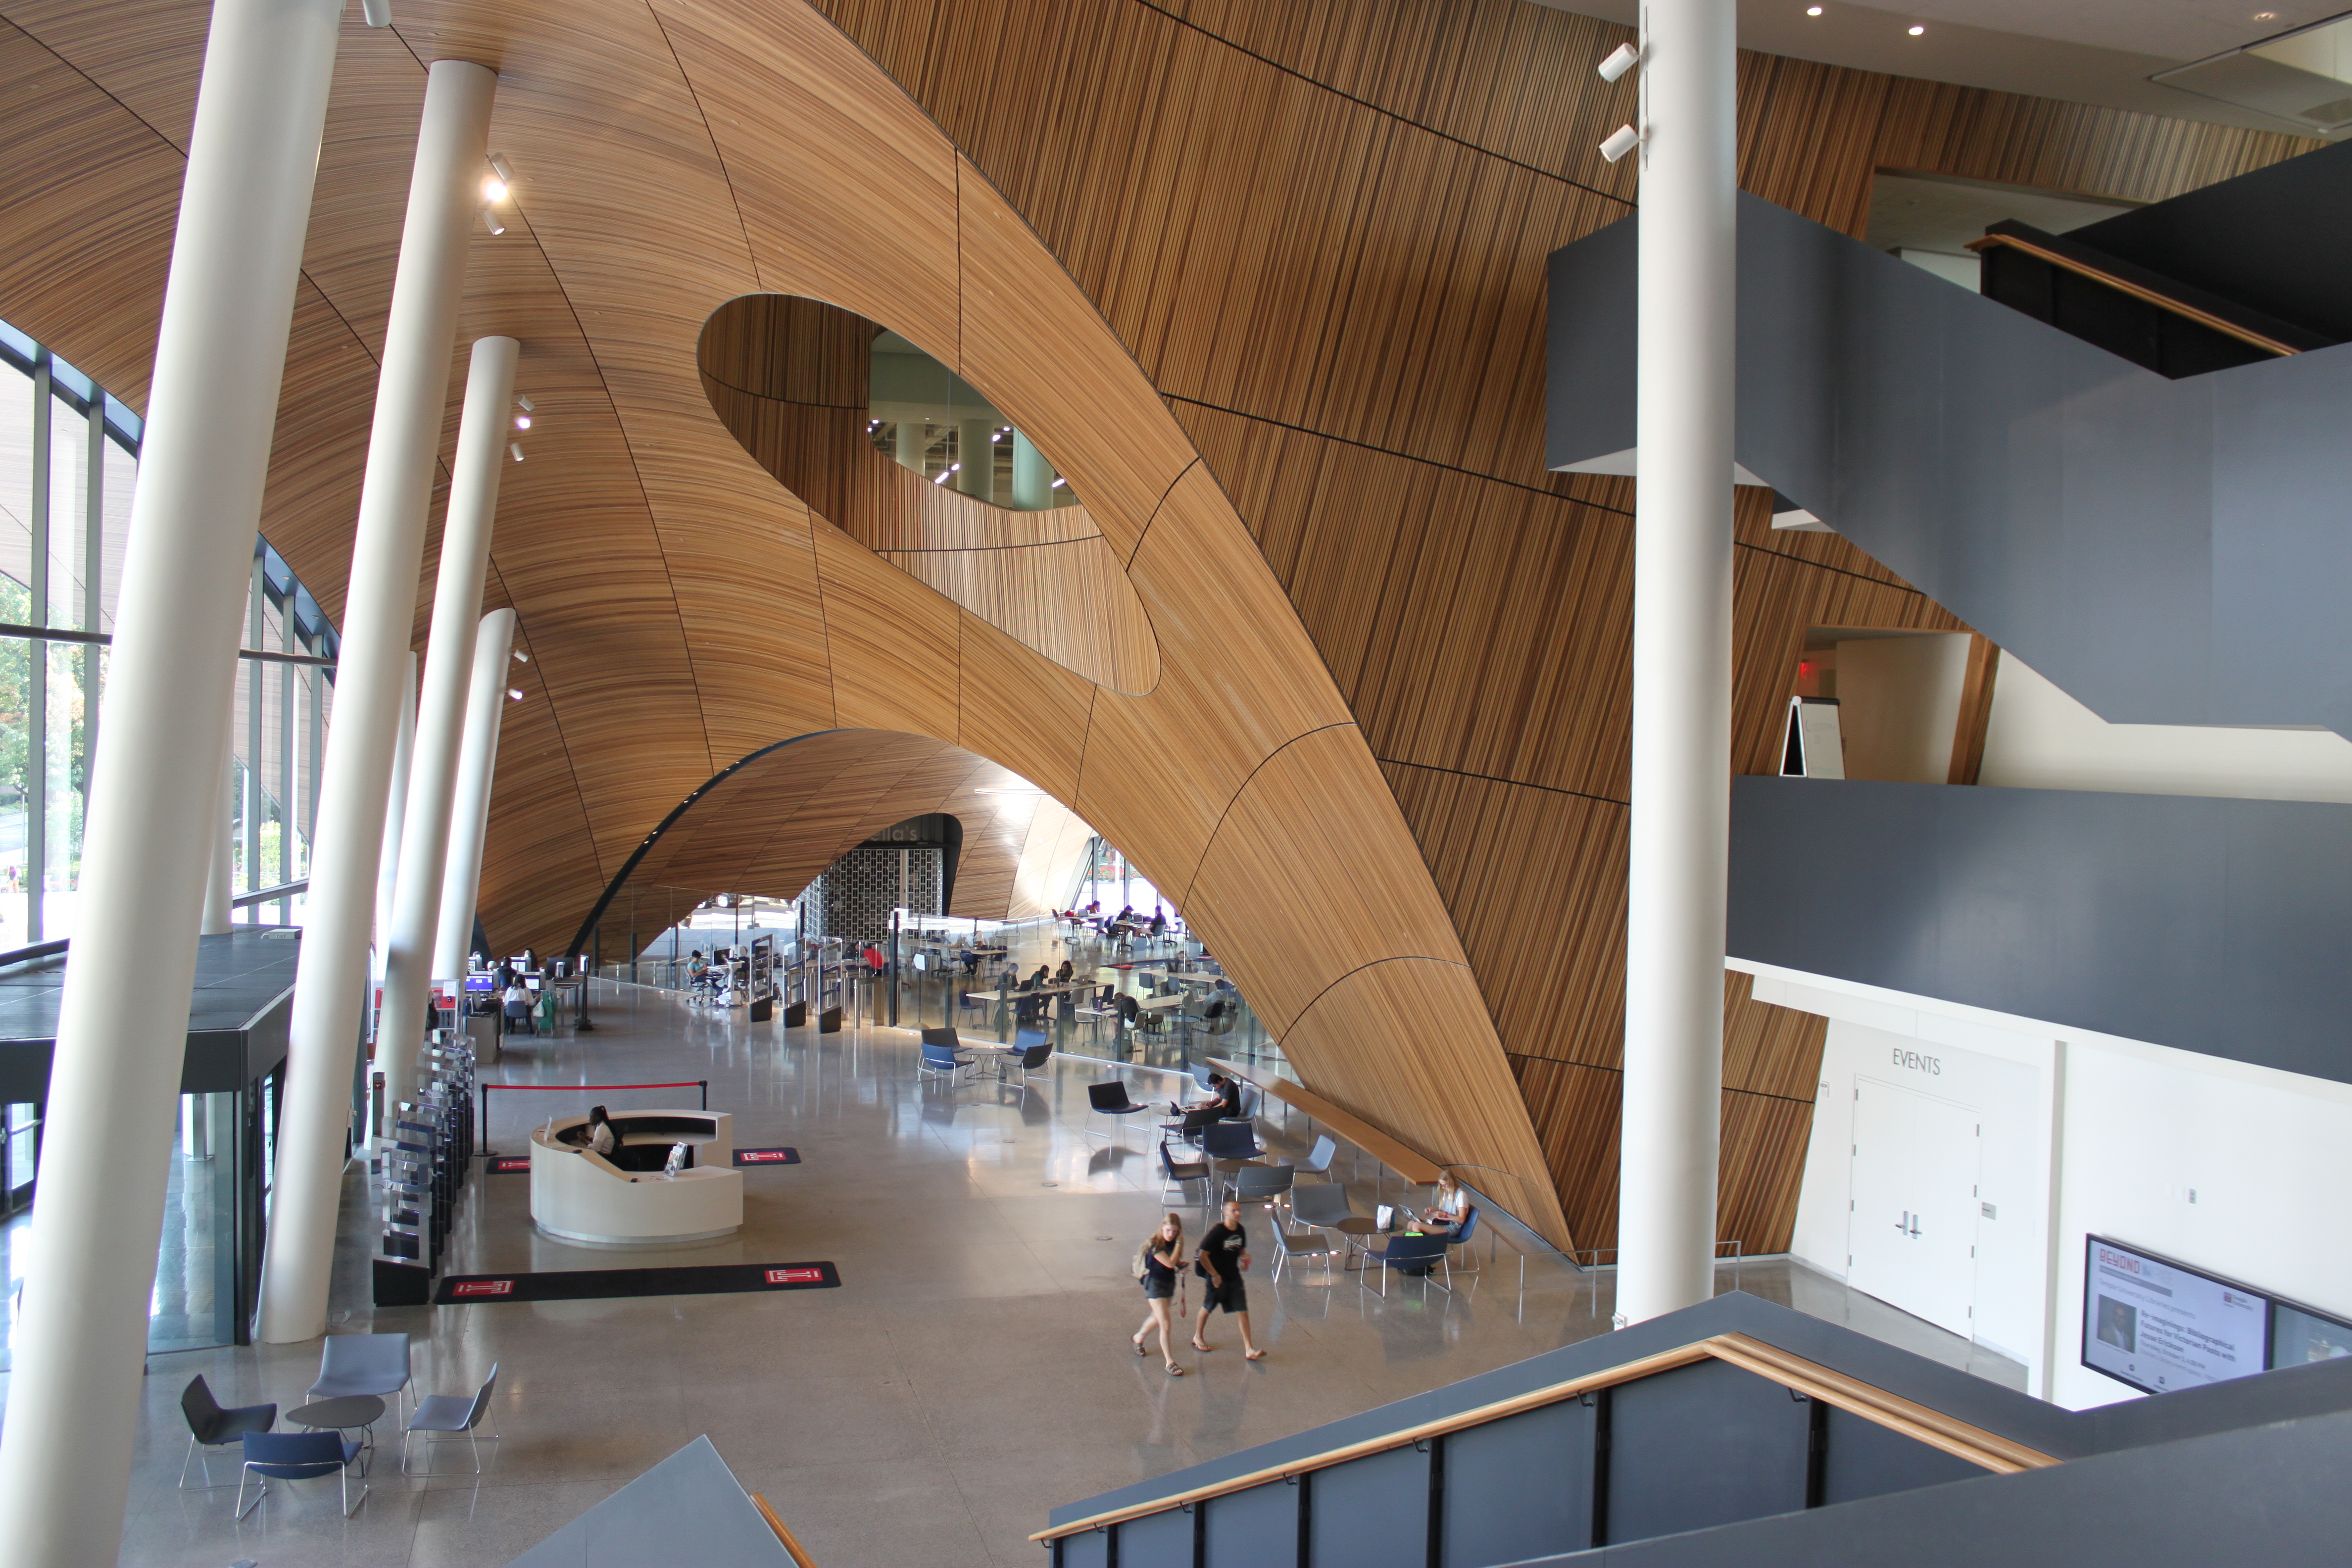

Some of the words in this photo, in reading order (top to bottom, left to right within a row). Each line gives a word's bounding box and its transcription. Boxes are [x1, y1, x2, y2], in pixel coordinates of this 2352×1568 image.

[1893, 1048, 1941, 1076] EVENTS
[2100, 1249, 2139, 1273] BEYOND
[2119, 1286, 2144, 1301] University
[2141, 1321, 2161, 1333] Futures
[2174, 1333, 2200, 1348] Victorian
[2202, 1344, 2219, 1355] Pasts
[2222, 1351, 2235, 1361] with
[2141, 1330, 2156, 1341] Jesse
[2158, 1337, 2183, 1352] Erickson
[2187, 1327, 2235, 1352] Bibliographical
